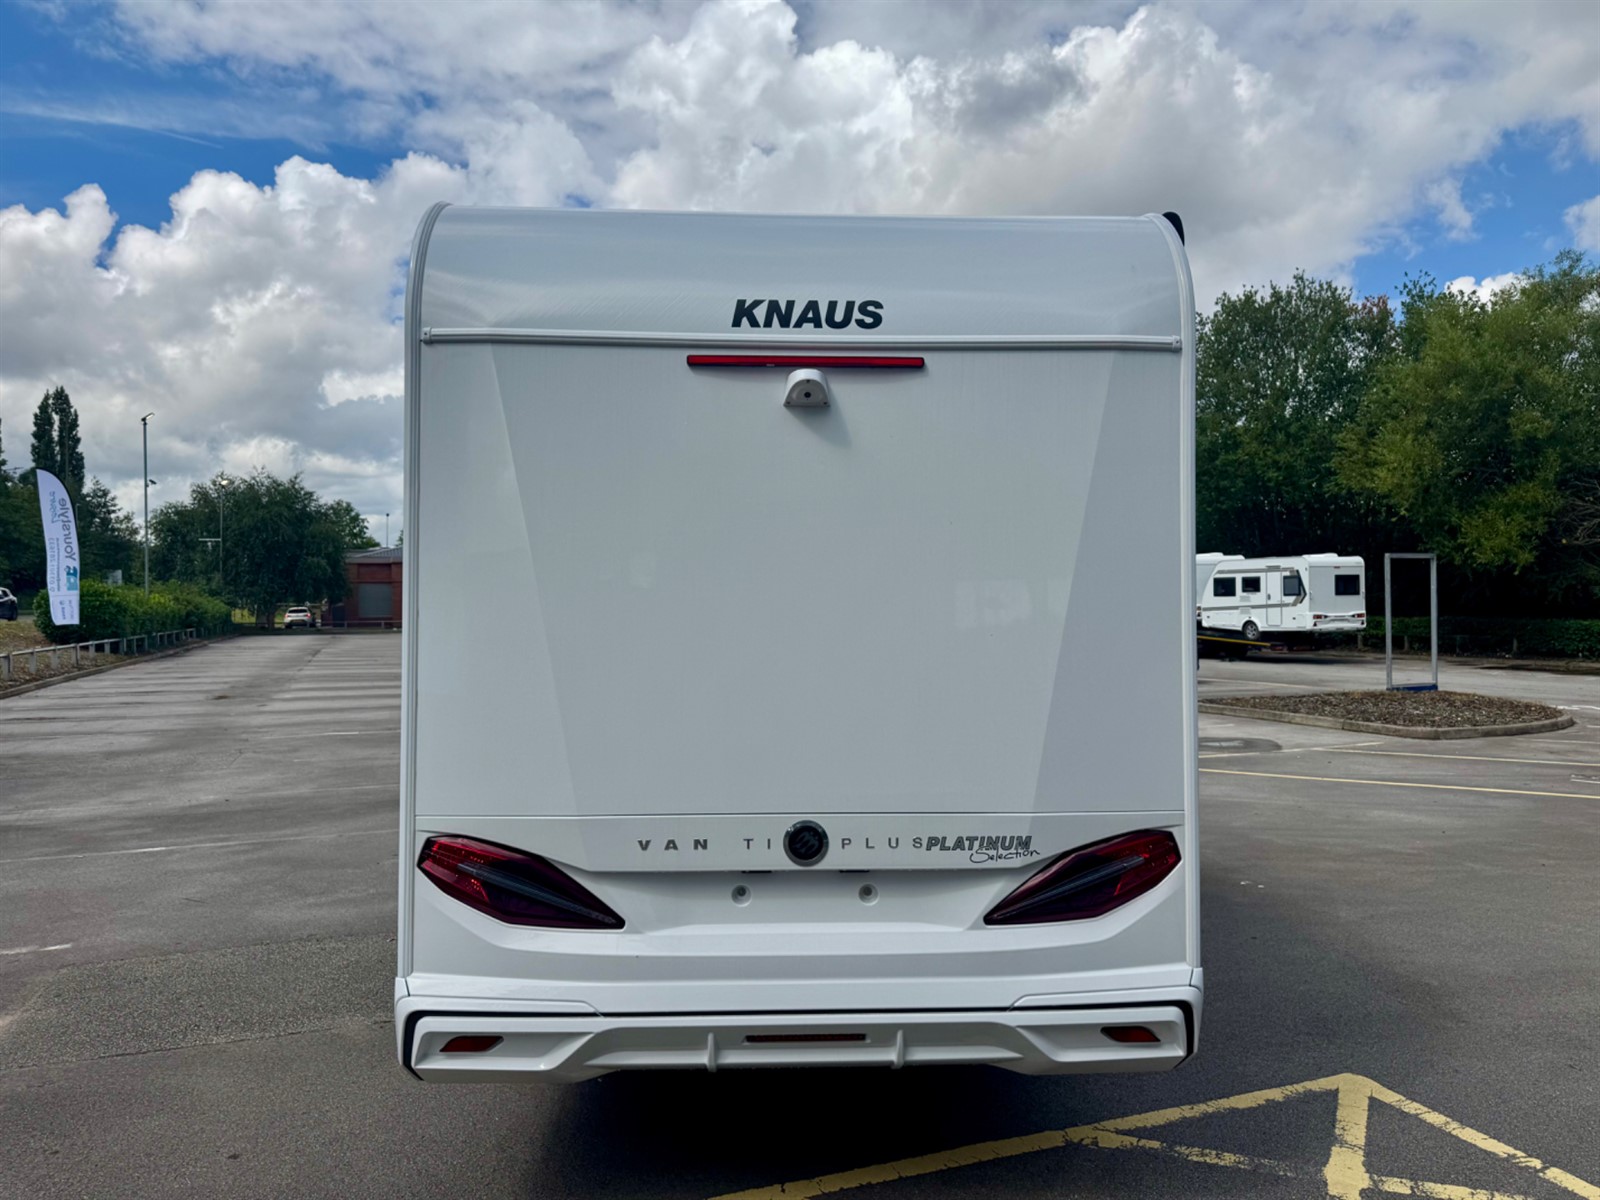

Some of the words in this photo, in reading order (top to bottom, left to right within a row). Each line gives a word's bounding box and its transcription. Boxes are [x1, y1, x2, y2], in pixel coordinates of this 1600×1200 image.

[731, 299, 884, 330] KNAUS
[637, 839, 708, 851] VAN
[743, 838, 771, 850] TI
[841, 837, 923, 849] PLUS
[926, 836, 1032, 851] PLATINUM
[969, 846, 1041, 863] Selection
